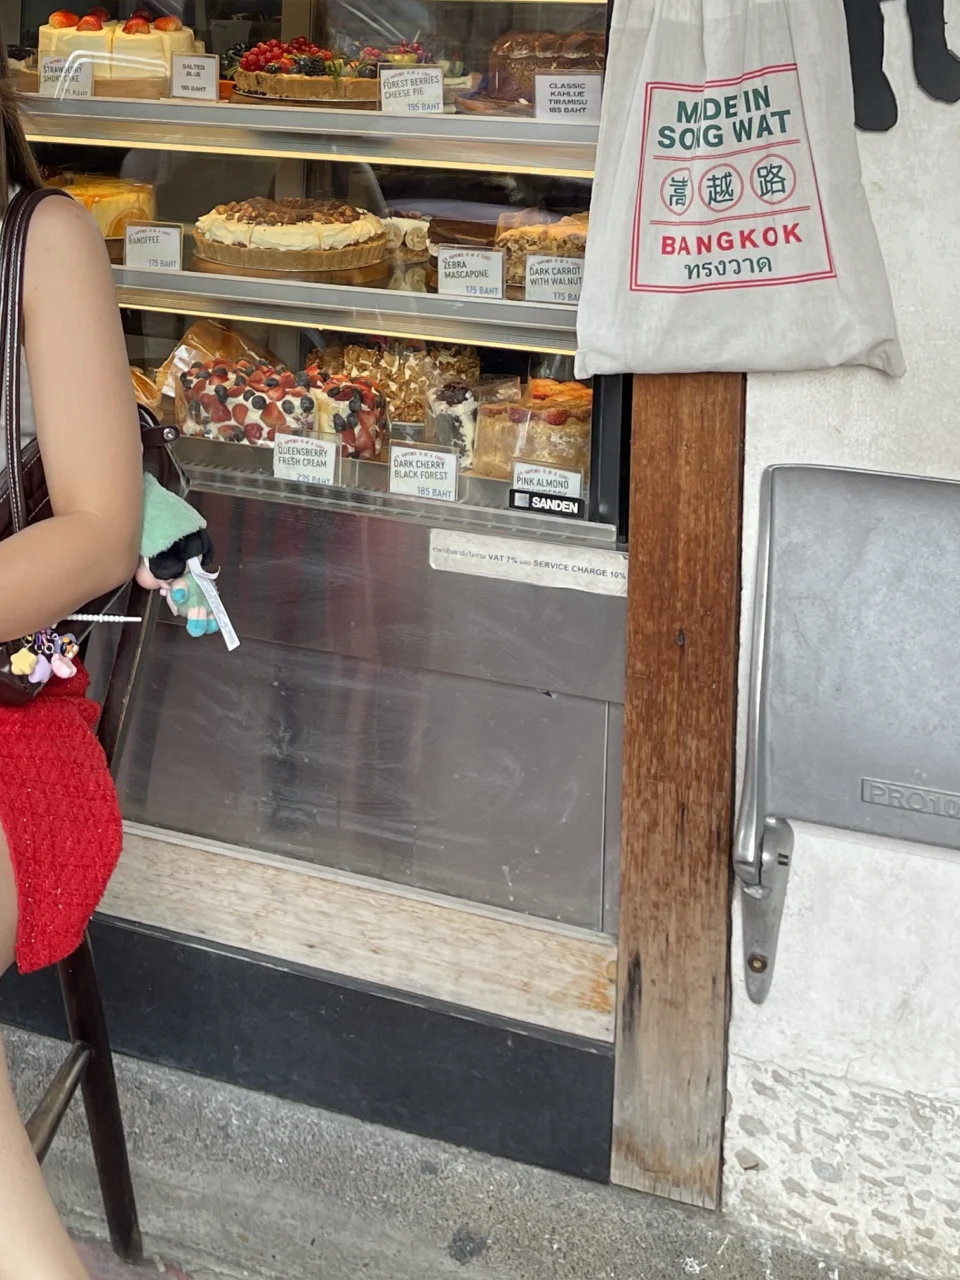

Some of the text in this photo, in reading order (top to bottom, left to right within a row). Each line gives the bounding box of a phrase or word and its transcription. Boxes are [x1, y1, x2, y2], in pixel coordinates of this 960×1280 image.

[182, 63, 205, 71] SALTED
[383, 77, 410, 89] FOREST
[410, 75, 440, 88] BERRIES
[384, 87, 424, 99] CHEESE PIE
[743, 85, 771, 113] IN
[421, 102, 440, 111] BAHT
[732, 109, 791, 143] WAT
[128, 236, 160, 245] BANOFFEE
[661, 222, 803, 256] BANGKOK
[148, 259, 177, 268] 175 BAHT
[443, 260, 467, 269] ZEBRA
[684, 256, 772, 279] ทรงวาด
[444, 270, 489, 279] MASCAPONE
[529, 266, 581, 276] DARK CARROT
[529, 276, 583, 286] WITH WALNUT
[465, 286, 499, 296] 175 BAHT
[553, 292, 581, 302] 175 BA
[278, 446, 328, 458] QUEENSBERRY
[278, 456, 327, 468] FRESH CREAM
[394, 459, 445, 469] DARK CHERRY
[296, 473, 330, 485] 235 BAHT
[394, 471, 448, 480] BLACK FOREST
[517, 477, 535, 486] PINK
[417, 486, 452, 499] 185 BAHT
[532, 497, 578, 513] SANDEN
[488, 553, 504, 562] VAT
[506, 556, 518, 564] 7%
[533, 560, 569, 572] SERVICE
[571, 566, 607, 577] CHARGE
[610, 571, 626, 580] 10%
